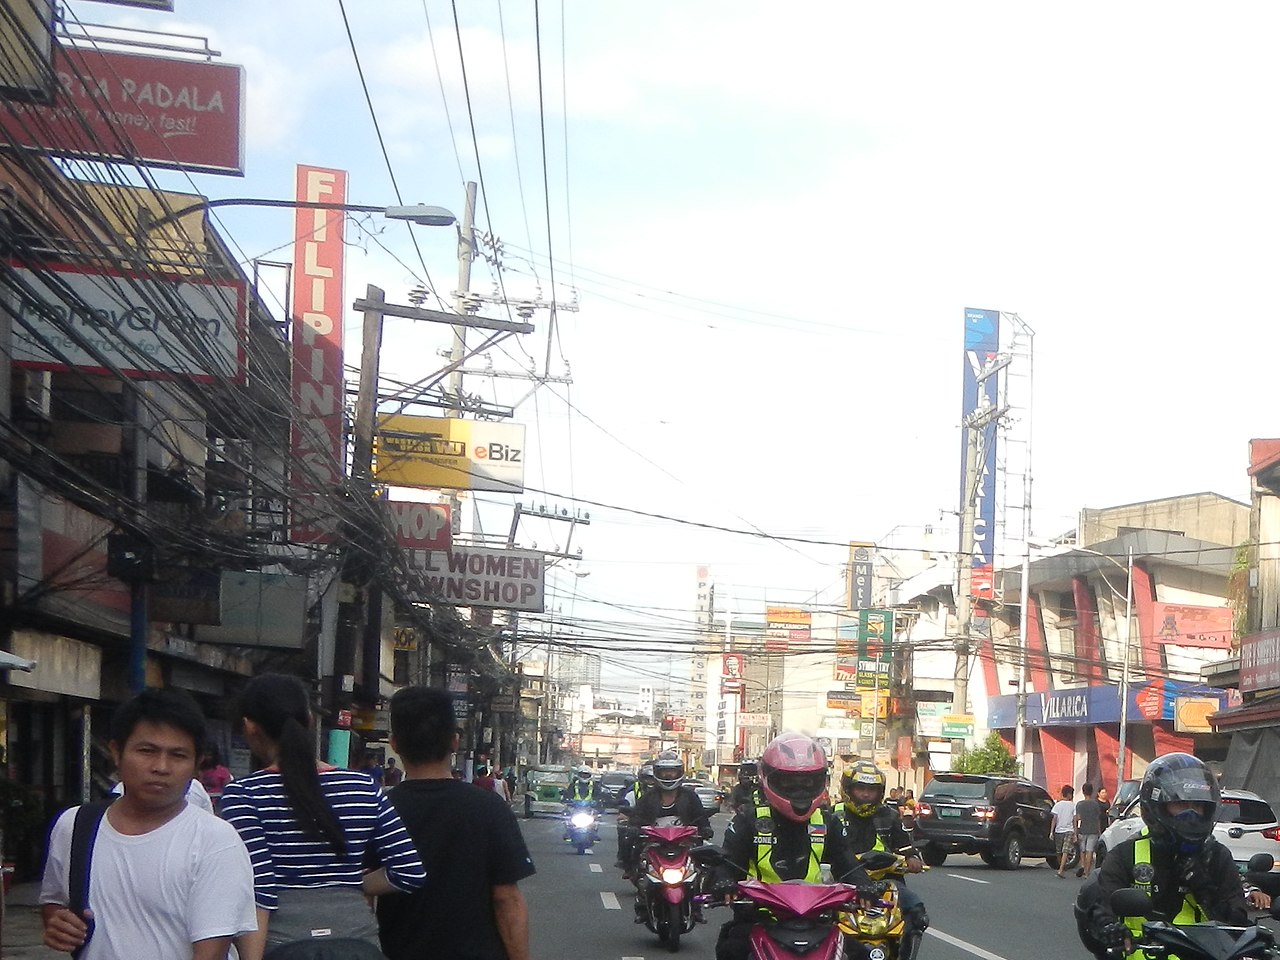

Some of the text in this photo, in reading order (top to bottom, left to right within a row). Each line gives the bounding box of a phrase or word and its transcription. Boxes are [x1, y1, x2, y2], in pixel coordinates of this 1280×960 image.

[123, 79, 224, 113] PADALA
[96, 109, 154, 130] money
[160, 115, 196, 132] fast!
[302, 170, 336, 487] FILIPINAS
[474, 443, 522, 463] eBiz
[966, 350, 996, 565] VILARICA
[390, 503, 447, 542] HOP
[406, 550, 540, 580] LL WOMEN
[405, 574, 537, 605] AWNSHOP
[858, 661, 890, 673] SYMMTRY
[1040, 693, 1089, 723] VILLARICA
[753, 836, 778, 844] ZONE 3
[1153, 885, 1160, 893] 3
